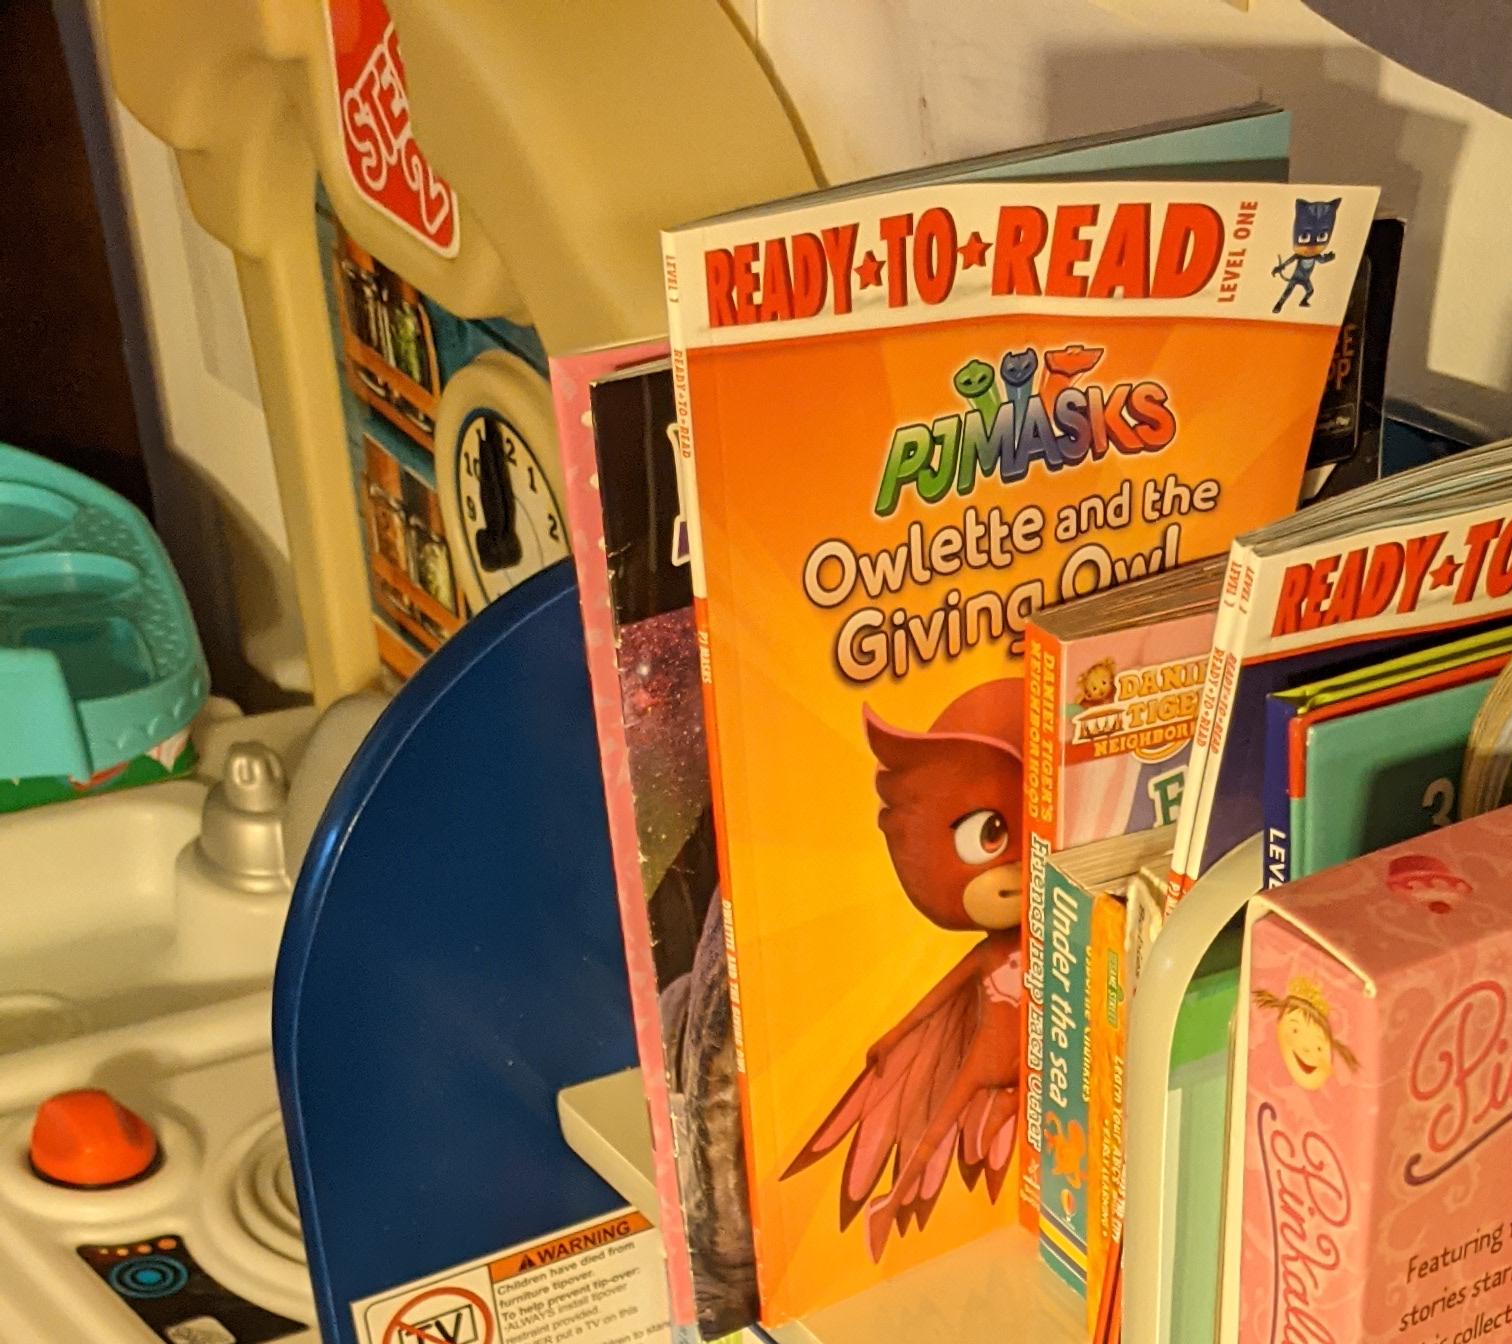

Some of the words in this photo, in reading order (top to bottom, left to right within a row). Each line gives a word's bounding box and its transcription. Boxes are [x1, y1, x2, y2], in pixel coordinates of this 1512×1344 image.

[704, 224, 862, 328] READY
[878, 207, 957, 308] TO
[990, 203, 1226, 299] READ
[1217, 243, 1245, 303] LEVEL
[1234, 200, 1259, 238] ONE
[803, 504, 1045, 609] Owlette
[1054, 487, 1132, 540] and
[1142, 474, 1221, 525] the
[836, 570, 1049, 688] Giving
[1061, 523, 1182, 596] Owl
[1271, 532, 1445, 638] READY
[1028, 638, 1042, 820] NEIGHBORHOOD
[1042, 652, 1055, 741] DANIEL
[1050, 886, 1080, 992] Under
[1050, 996, 1077, 1058] the
[1047, 1062, 1071, 1109] sea
[497, 1273, 547, 1296] Children
[550, 1261, 577, 1278] have
[580, 1251, 606, 1267] died
[608, 1241, 636, 1257] from
[538, 1220, 632, 1264] WARNING
[1406, 1221, 1505, 1284] Featuring
[519, 1300, 545, 1317] help
[548, 1284, 591, 1308] prevent
[1399, 1284, 1467, 1333] stories
